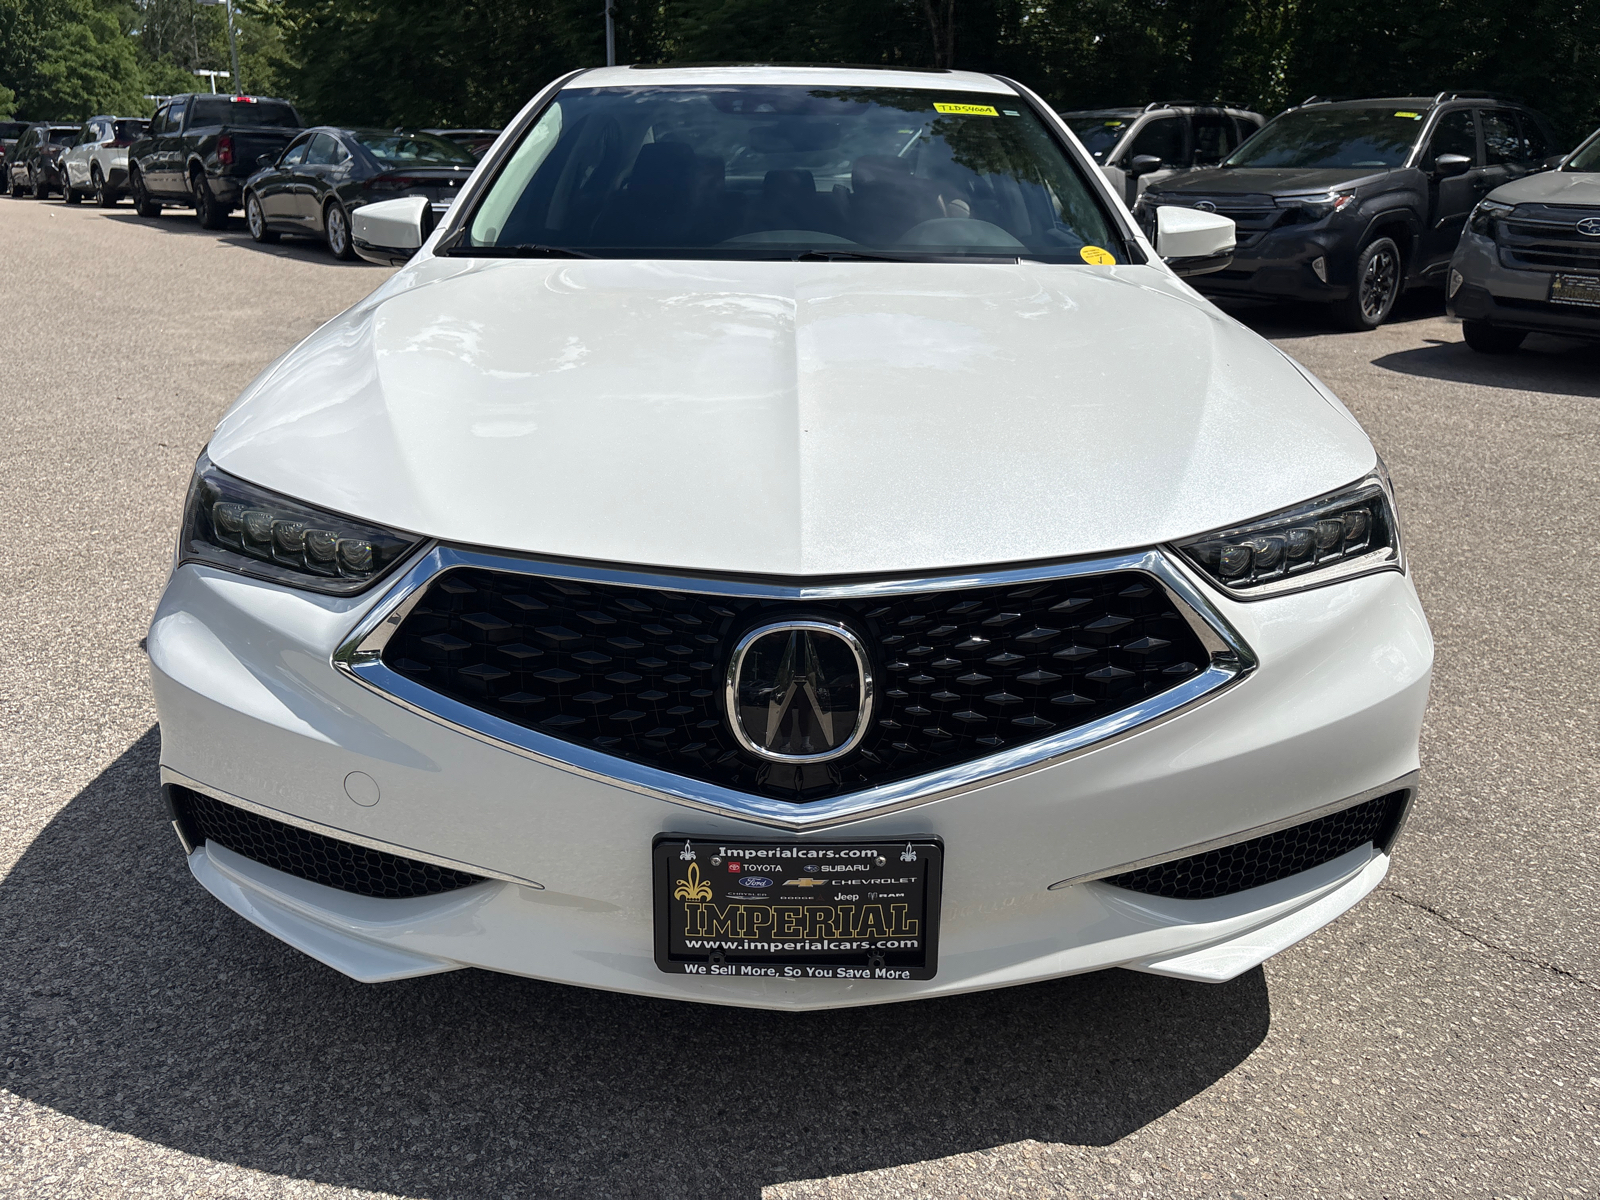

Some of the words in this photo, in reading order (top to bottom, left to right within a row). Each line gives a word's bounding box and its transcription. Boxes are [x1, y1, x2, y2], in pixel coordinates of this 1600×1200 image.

[719, 847, 878, 859] Imperialcars.com
[743, 864, 782, 872] TOYOTA
[821, 864, 870, 872] SUBARU
[743, 877, 768, 888] Ford
[832, 877, 918, 886] CHEVROLET
[834, 893, 859, 902] Jeep
[685, 903, 919, 939] IMPERIAL
[685, 940, 918, 952] www.imperialcars.com
[683, 963, 707, 974] We
[710, 964, 736, 975] Sell
[741, 965, 780, 978] More,
[784, 966, 802, 977] So
[806, 967, 833, 978] You
[836, 967, 871, 978] Save
[875, 968, 910, 979] More
